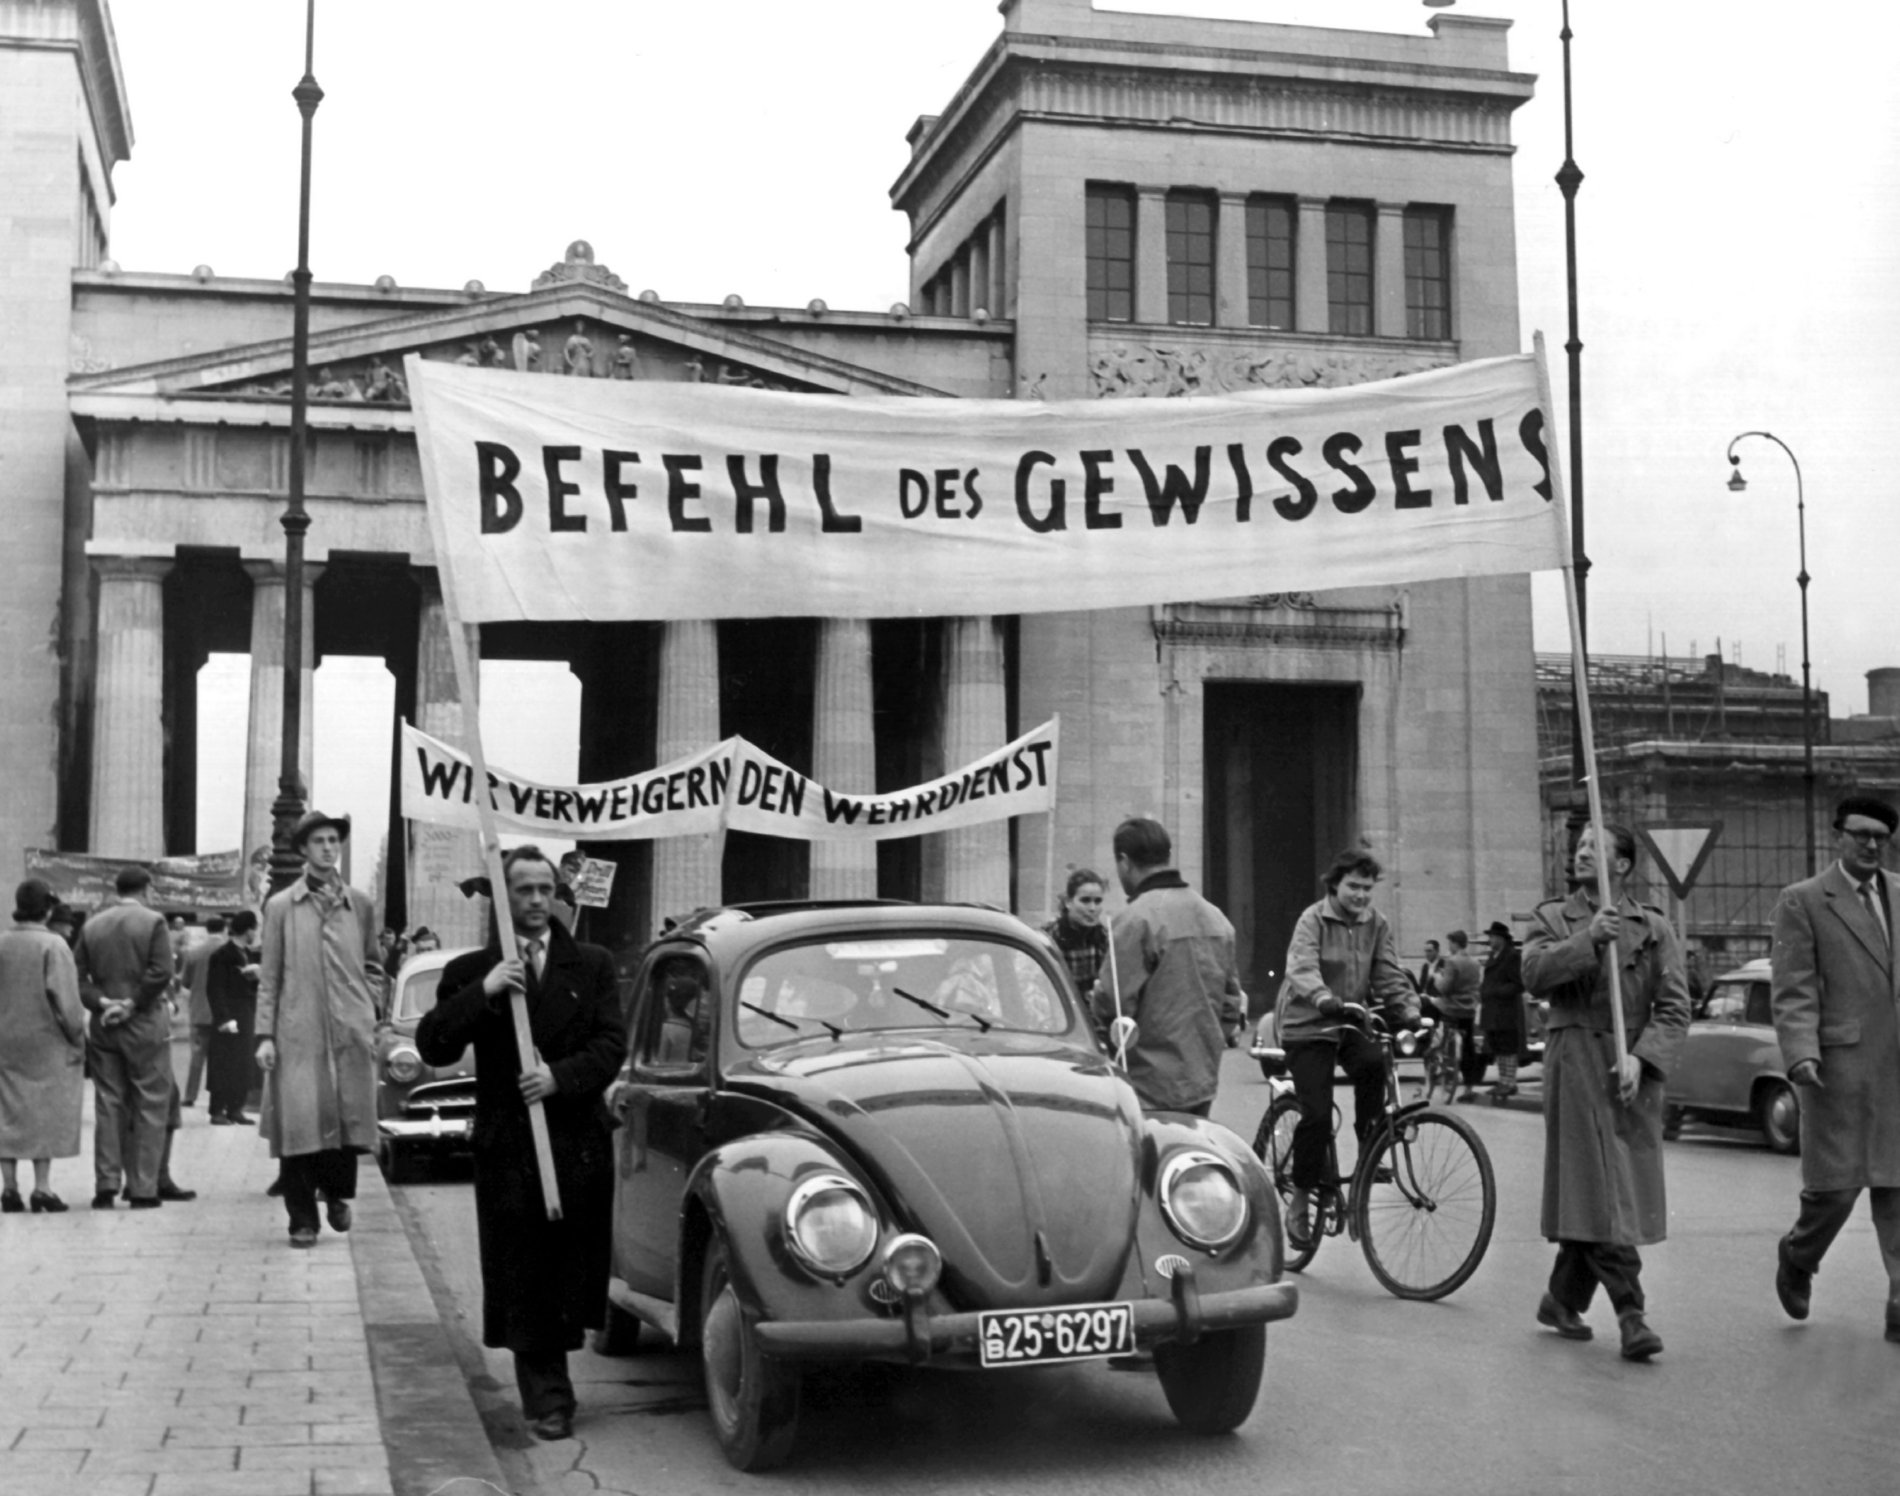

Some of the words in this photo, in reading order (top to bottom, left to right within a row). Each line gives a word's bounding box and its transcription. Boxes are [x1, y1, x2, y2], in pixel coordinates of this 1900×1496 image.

[475, 440, 862, 535] BEFEHL
[898, 467, 984, 519] DES
[1014, 406, 1554, 533] GEWISSENS
[509, 757, 731, 823] VERWEIGERN
[738, 759, 806, 817] DEN
[823, 741, 1052, 825] WEHRDIENST
[1004, 1309, 1128, 1358] 25-6297
